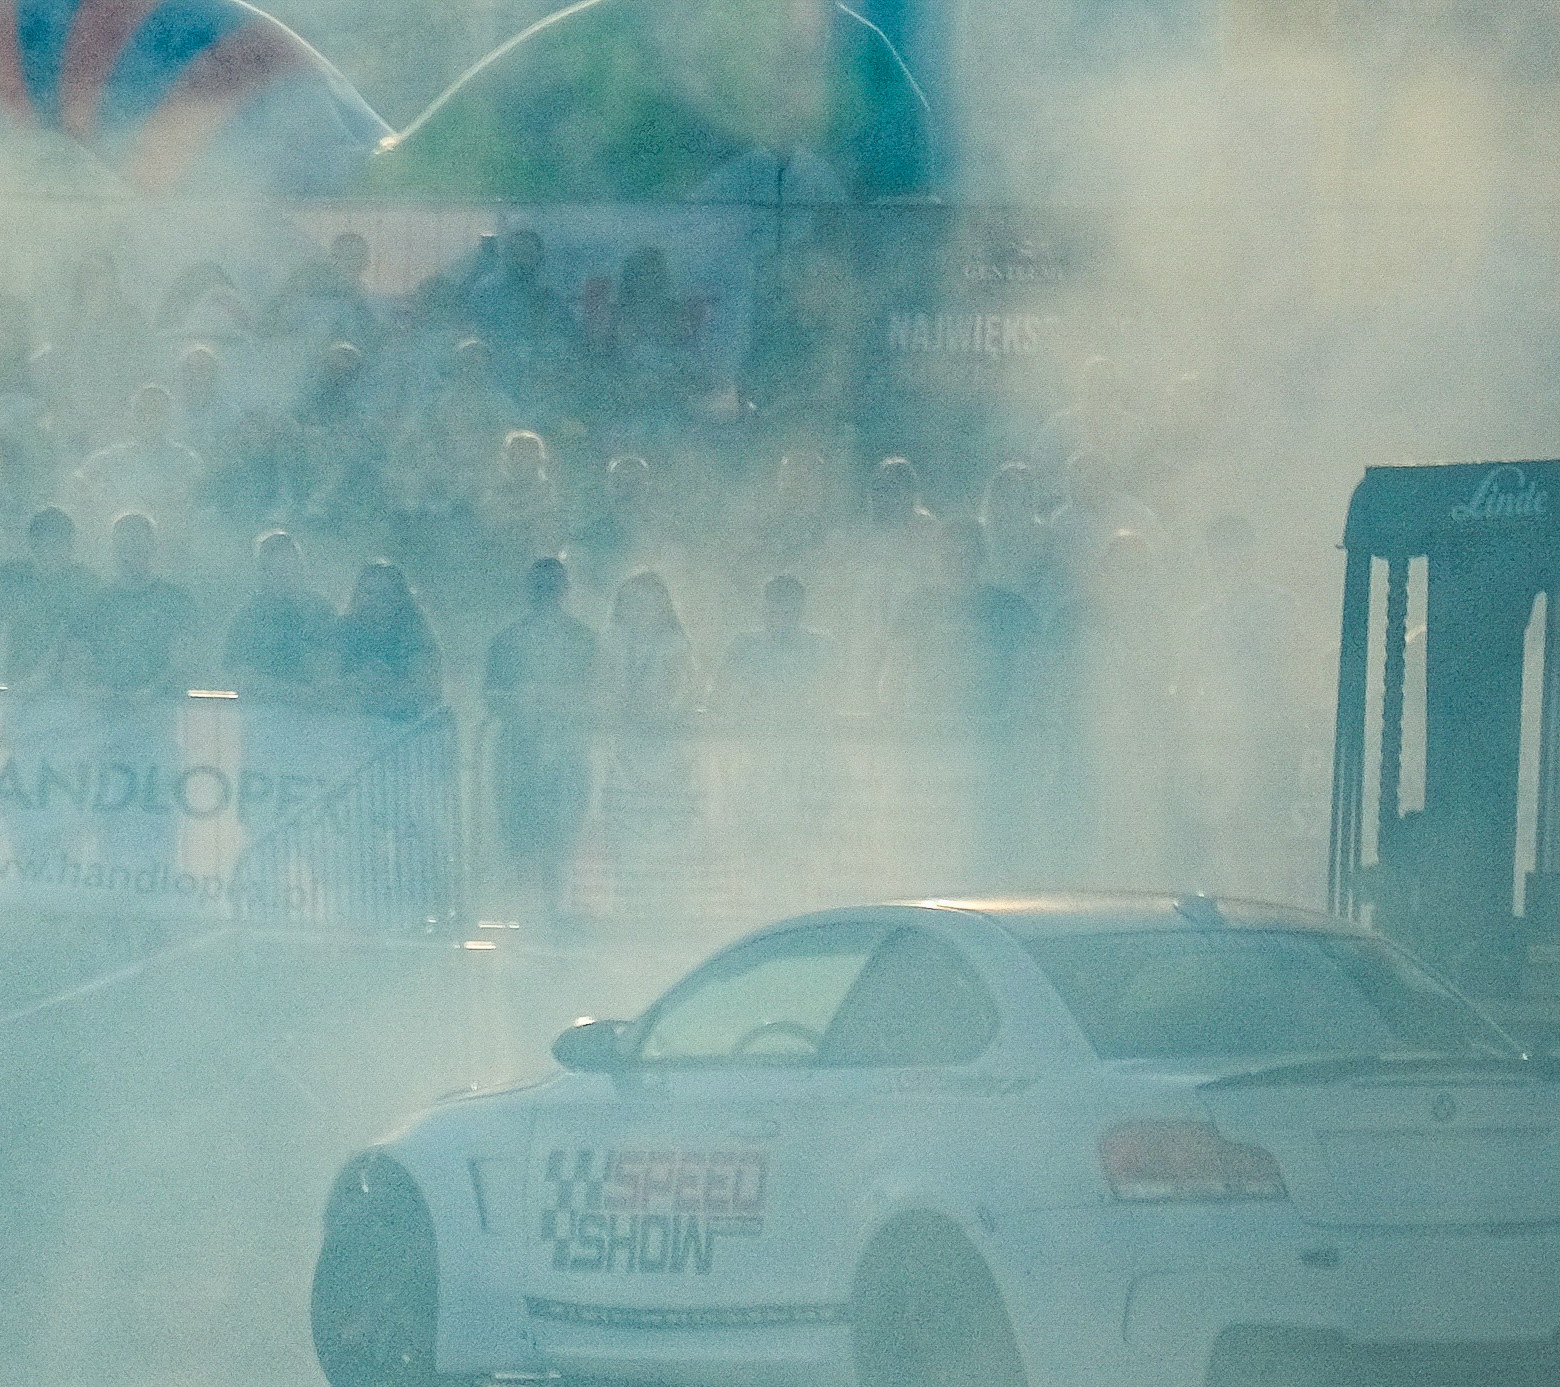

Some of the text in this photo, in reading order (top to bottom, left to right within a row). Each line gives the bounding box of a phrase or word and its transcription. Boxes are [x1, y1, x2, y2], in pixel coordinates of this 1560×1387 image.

[1450, 466, 1550, 521] Linde
[604, 1150, 768, 1212] SPEED
[570, 1213, 716, 1276] SHOW
